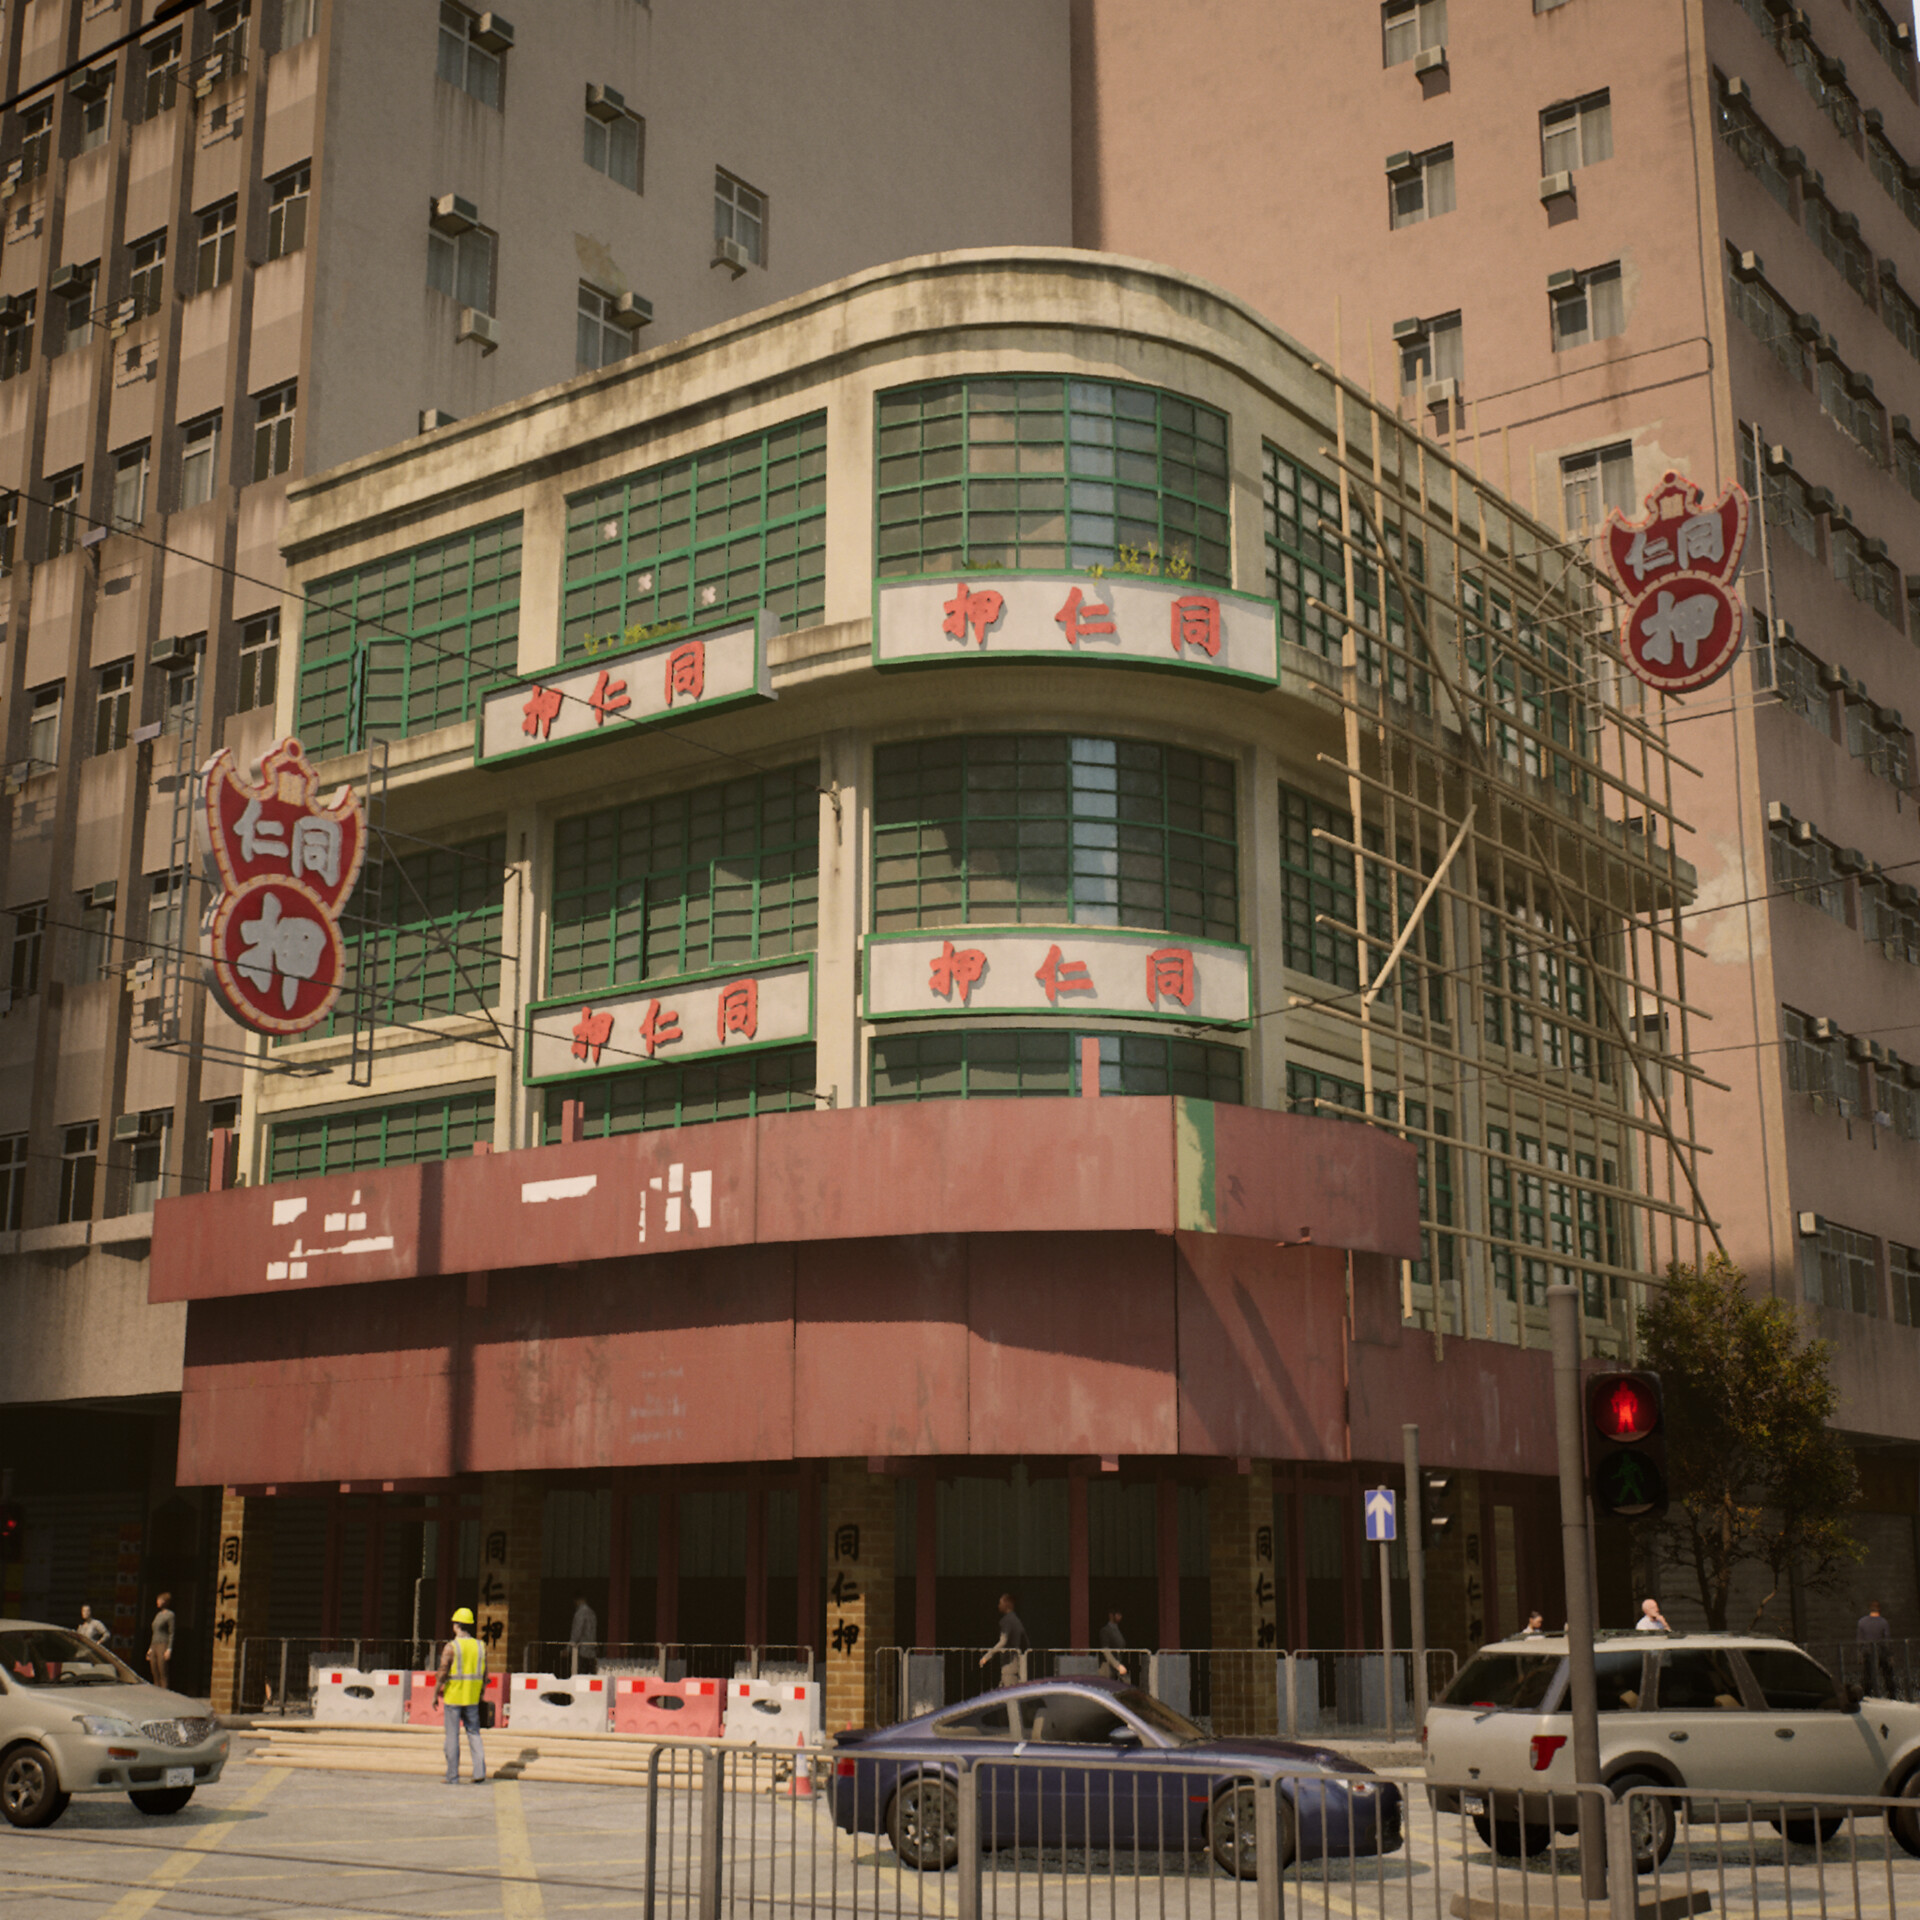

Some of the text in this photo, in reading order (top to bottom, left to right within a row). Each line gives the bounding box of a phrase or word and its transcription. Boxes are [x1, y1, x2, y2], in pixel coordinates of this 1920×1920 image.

[1640, 590, 1719, 669] 押
[236, 892, 327, 1011] 押
[216, 1536, 240, 1645] 同仁押
[832, 1524, 860, 1658] 同仁押
